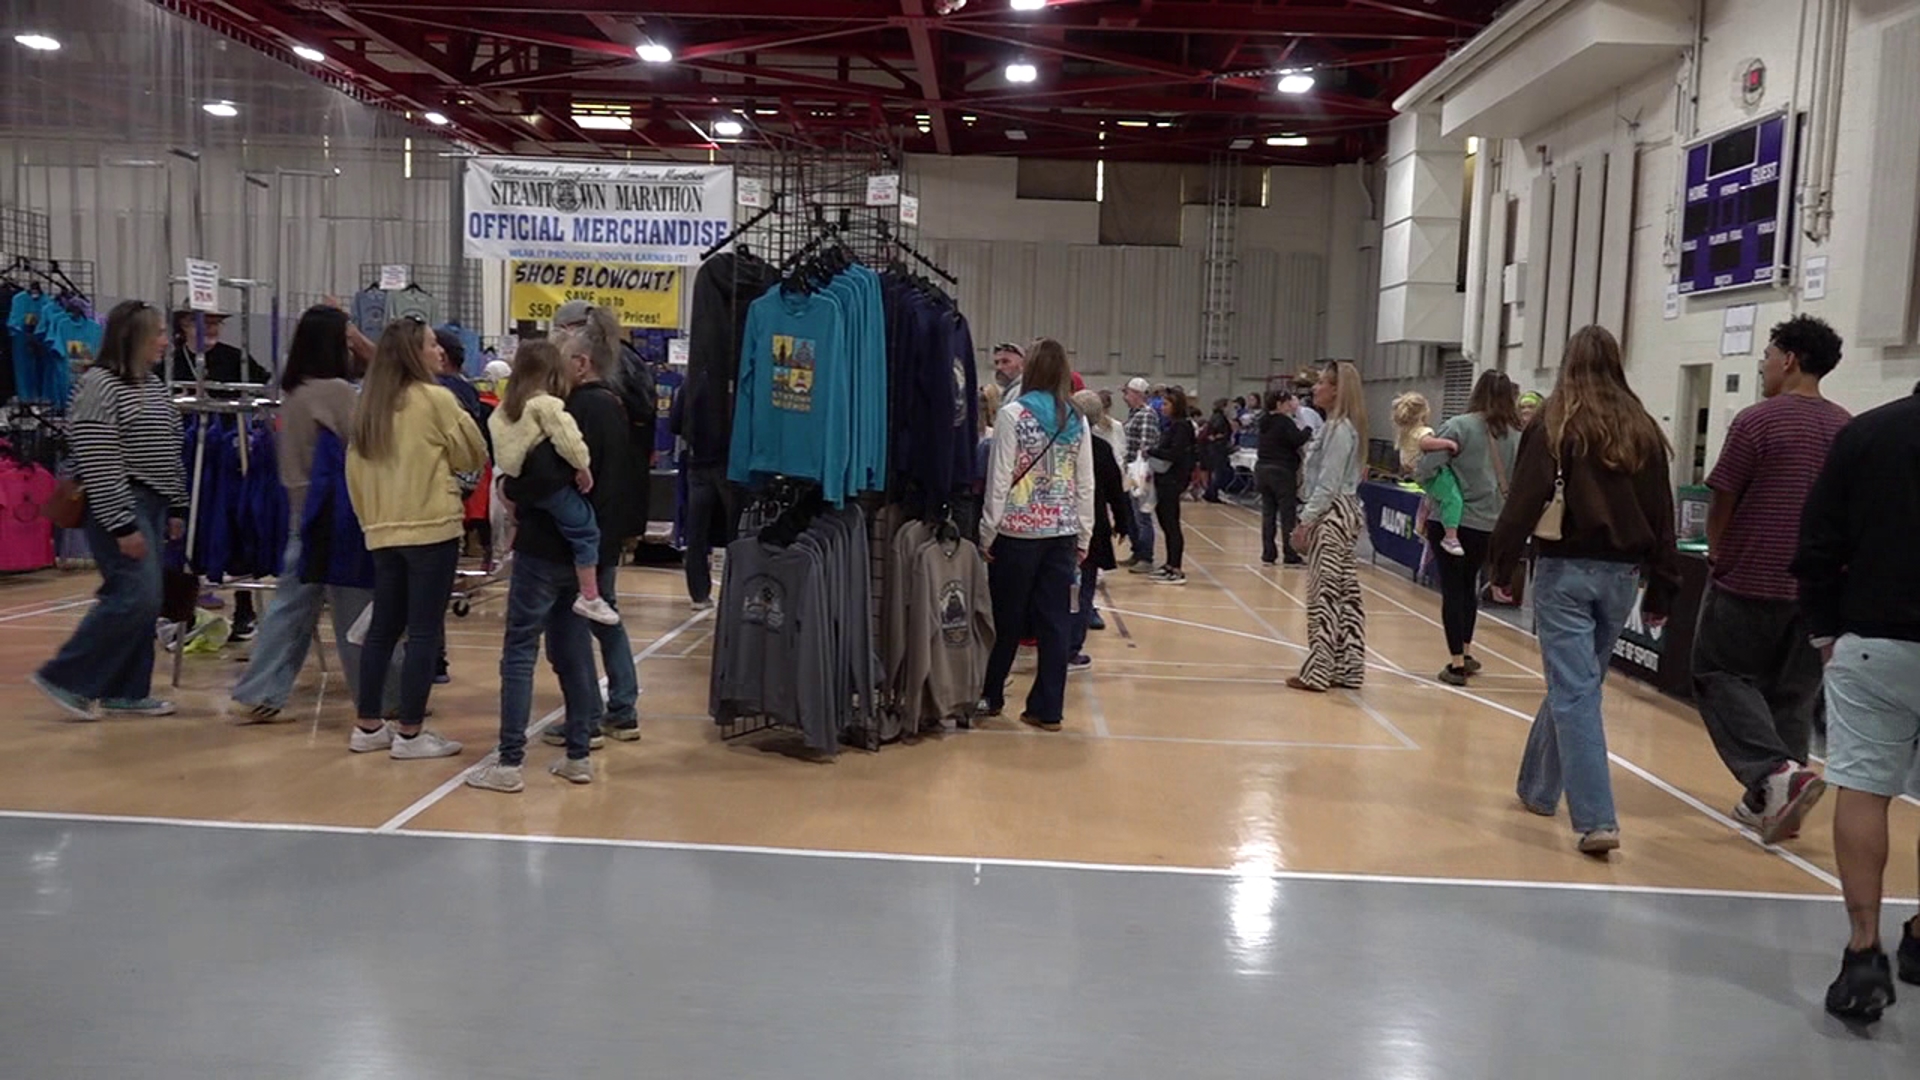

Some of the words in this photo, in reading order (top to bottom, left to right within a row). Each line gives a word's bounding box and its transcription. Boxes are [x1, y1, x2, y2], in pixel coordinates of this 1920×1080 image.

[661, 168, 705, 180] Marathon
[1751, 161, 1778, 184] GUEST
[615, 184, 703, 213] MARATHON
[1688, 183, 1709, 202] HOME
[469, 212, 564, 241] OFFICIAL
[573, 217, 727, 246] MERCHANDISE
[1709, 232, 1728, 246] PLAYER
[634, 252, 673, 263] EARNED
[515, 263, 566, 285] SHOE
[572, 266, 675, 292] BLOWOUT!
[564, 290, 595, 303] SAVE
[613, 296, 625, 307] to
[528, 303, 552, 318] $50
[624, 311, 661, 325] Prices!
